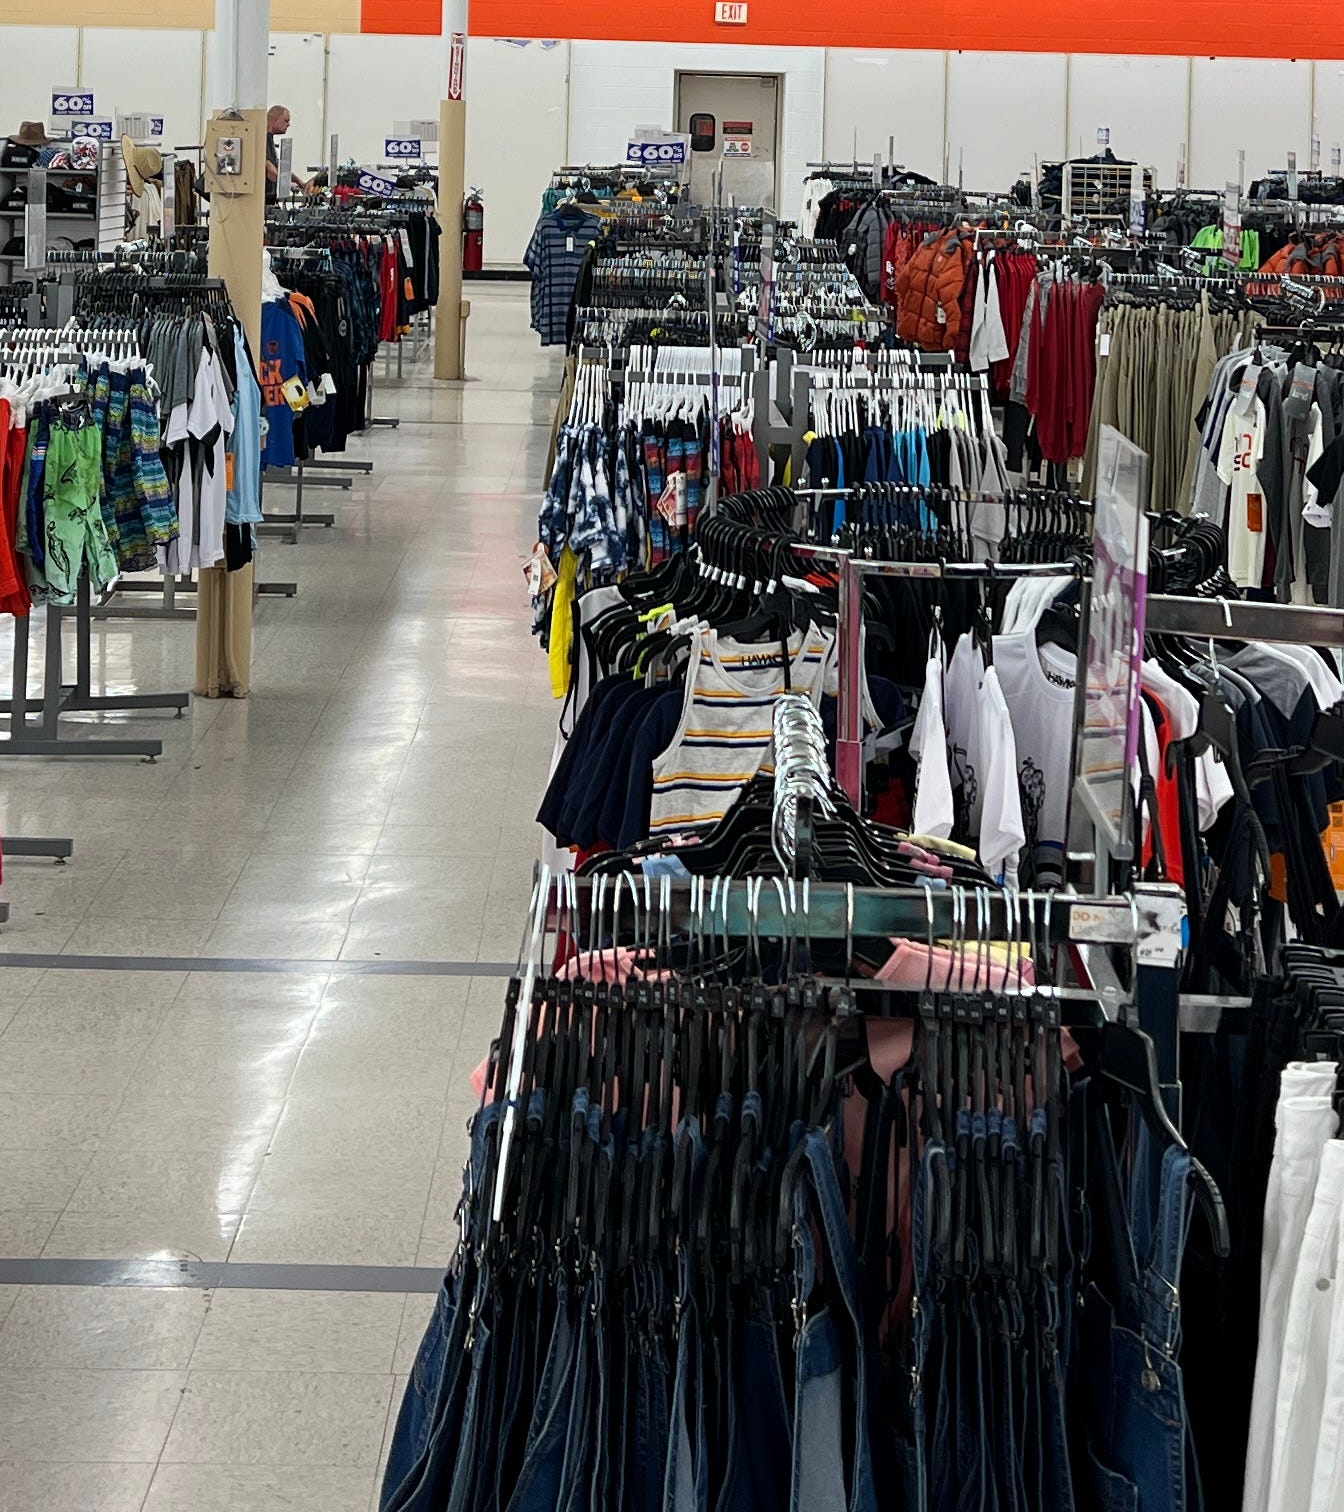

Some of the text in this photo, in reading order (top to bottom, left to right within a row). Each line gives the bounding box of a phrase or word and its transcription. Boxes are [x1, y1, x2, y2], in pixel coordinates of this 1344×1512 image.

[721, 3, 743, 20] EXIT
[53, 96, 92, 111] 60%
[386, 141, 419, 153] 60%
[643, 145, 683, 160] 60%
